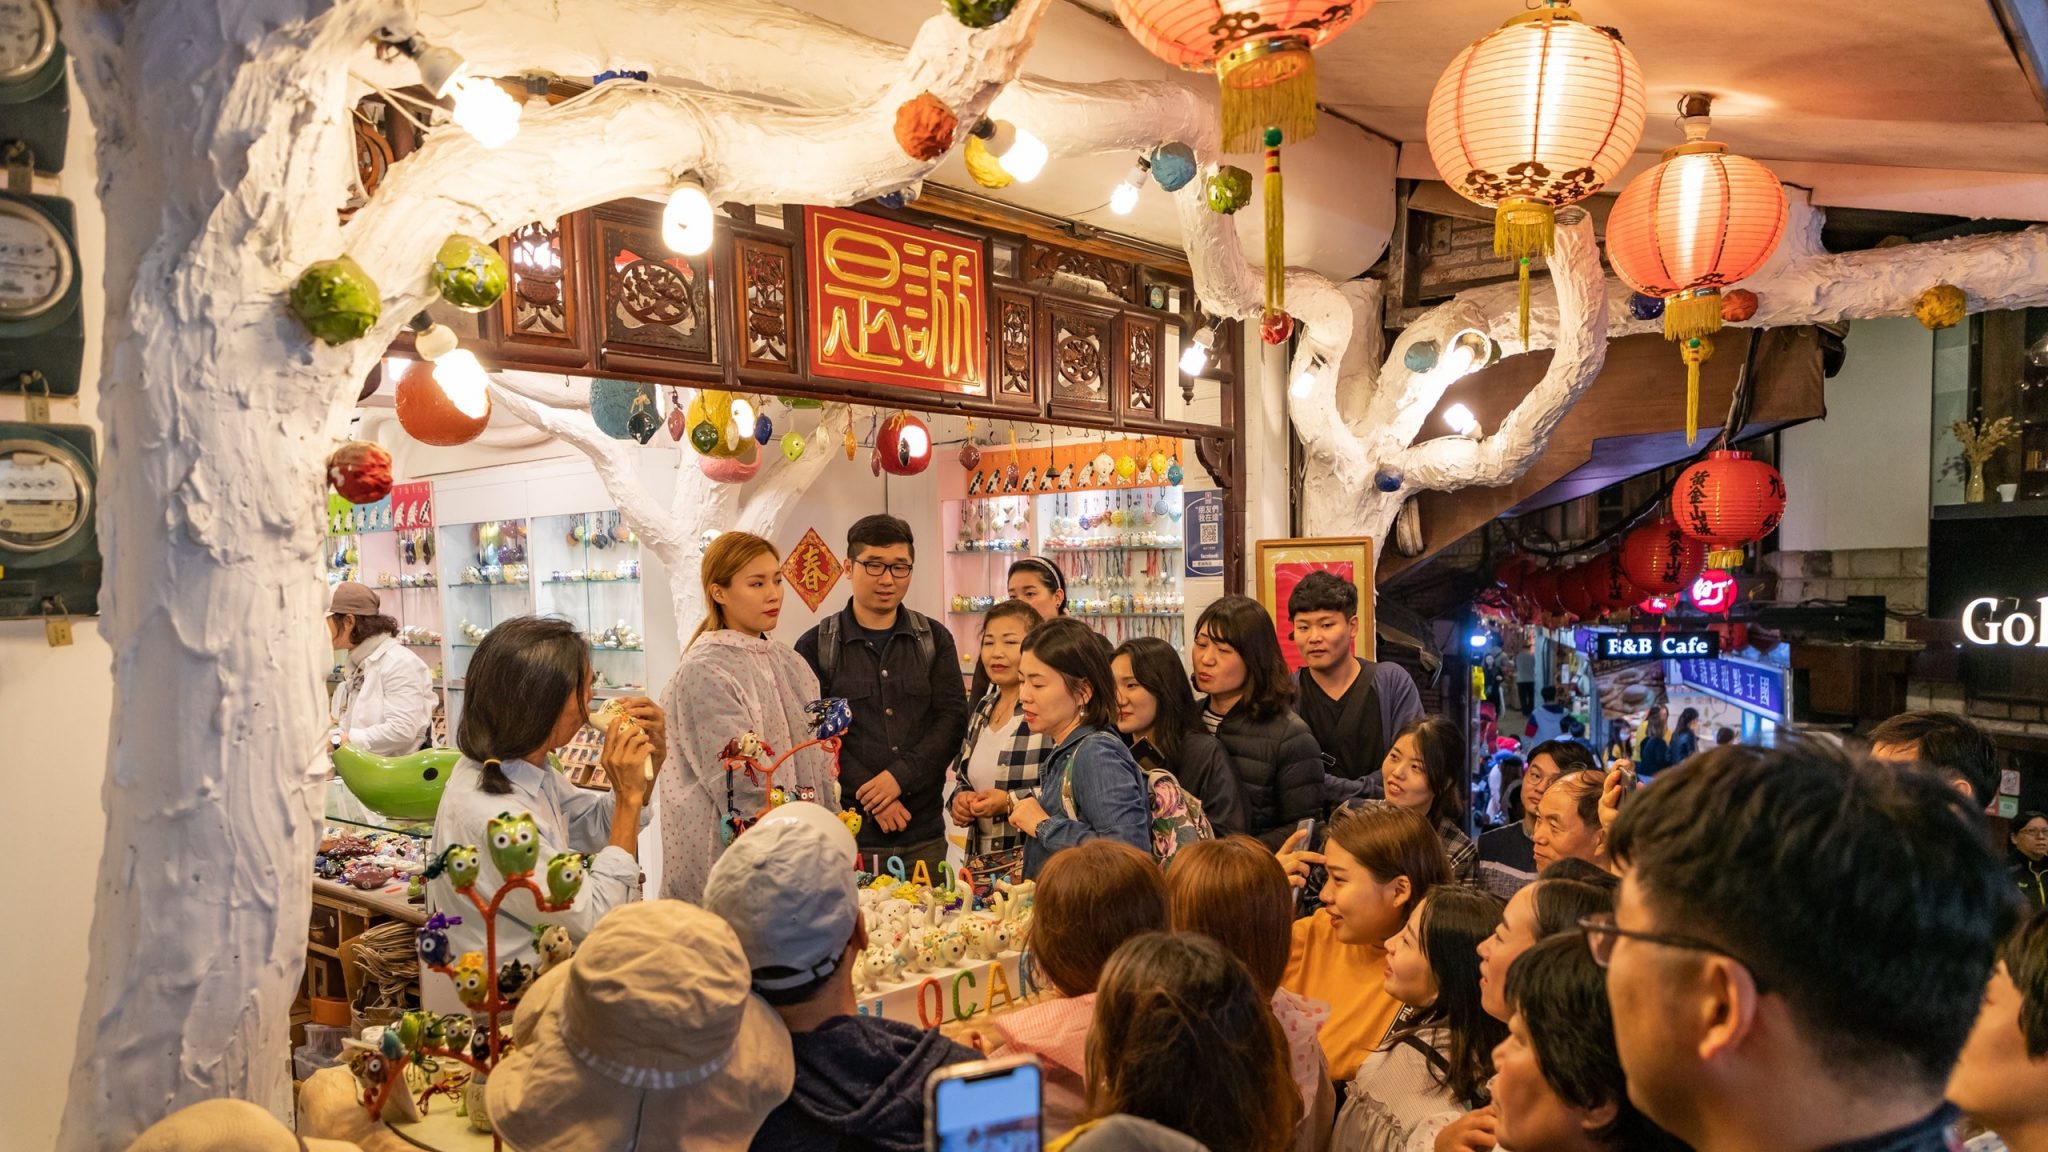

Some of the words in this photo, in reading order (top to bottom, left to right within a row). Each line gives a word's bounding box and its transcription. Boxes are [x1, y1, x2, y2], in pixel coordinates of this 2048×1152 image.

[798, 545, 829, 592] 春
[1608, 638, 1652, 655] B&B
[1662, 636, 1709, 655] Cafe
